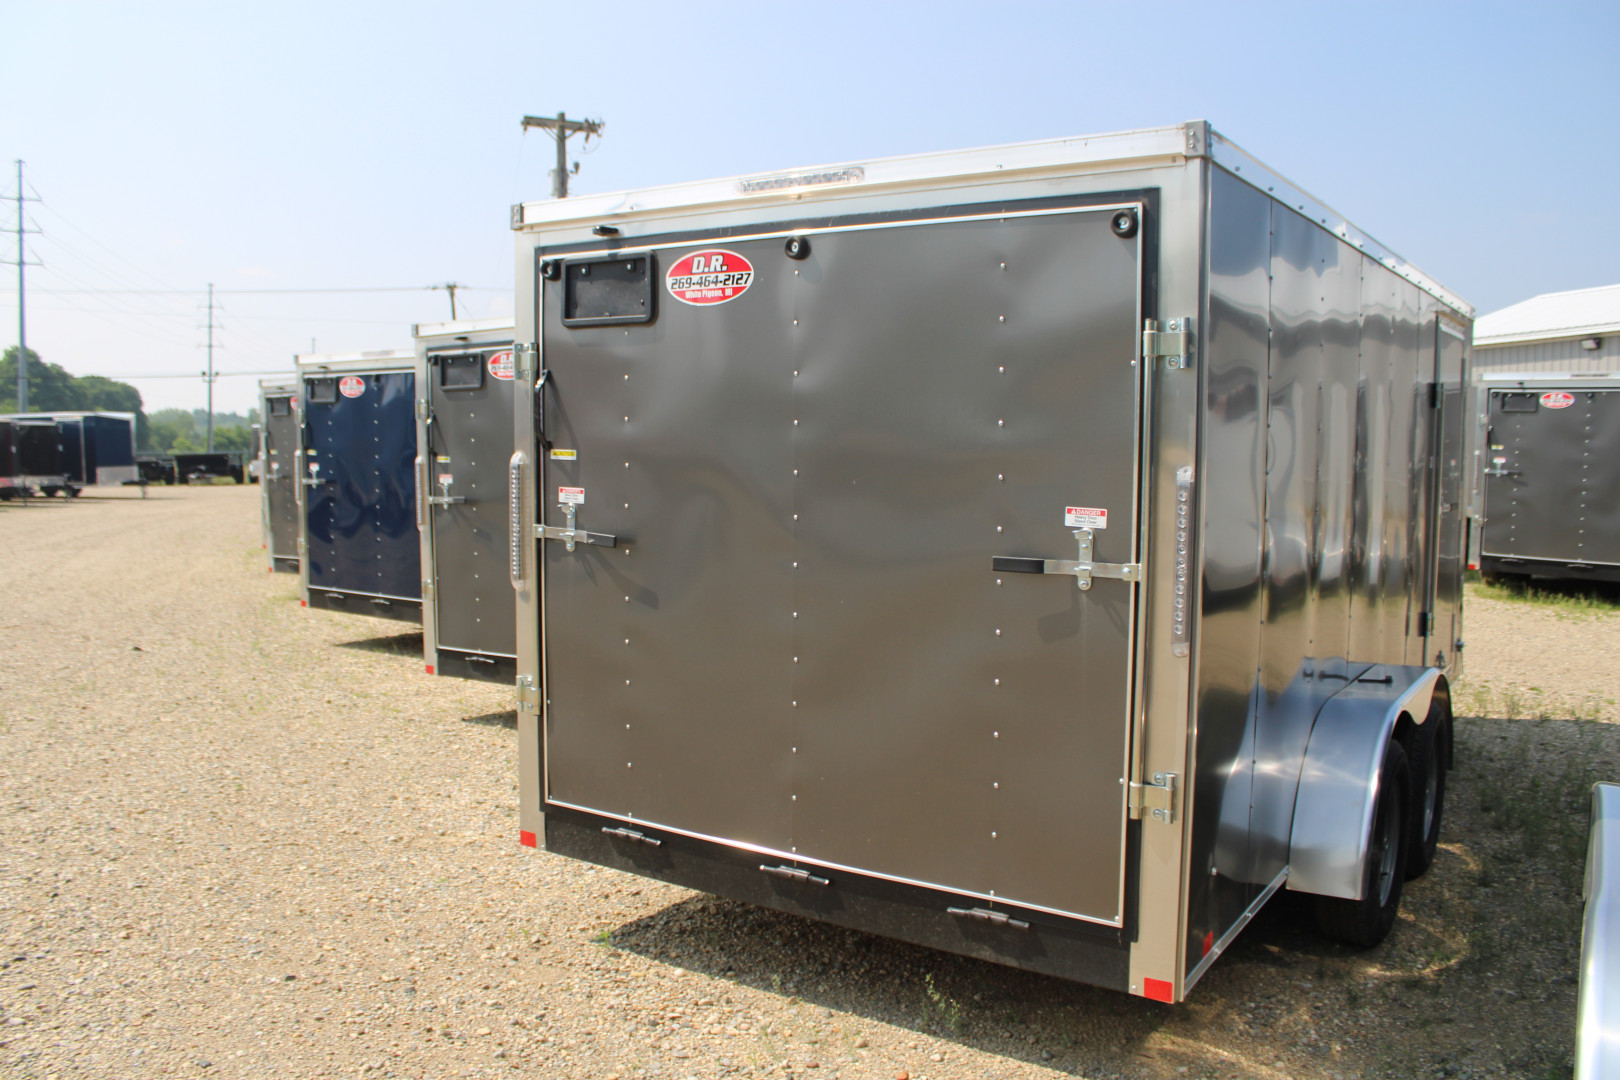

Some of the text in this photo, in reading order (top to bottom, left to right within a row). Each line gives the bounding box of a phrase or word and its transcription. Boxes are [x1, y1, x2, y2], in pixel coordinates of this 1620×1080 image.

[691, 254, 728, 274] D.R.
[671, 272, 752, 290] 269-464-2127
[685, 290, 701, 299] White
[1077, 508, 1101, 516] DANGER
